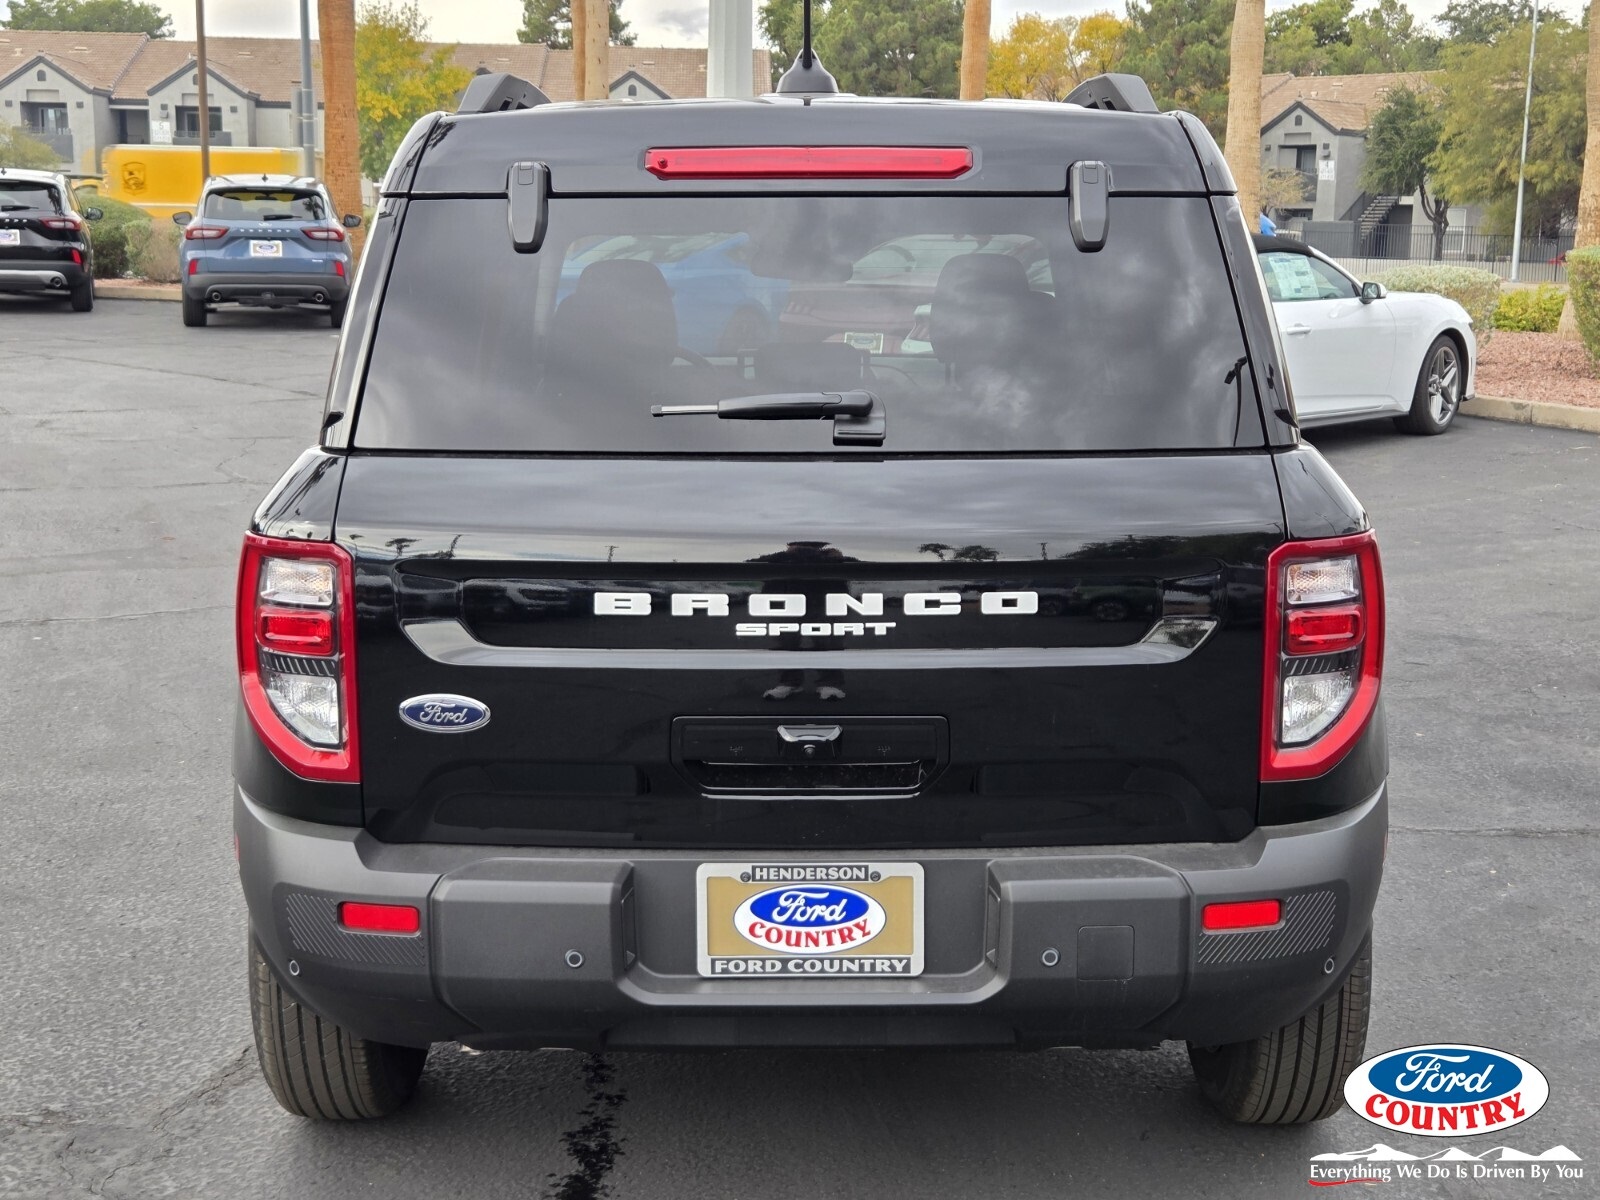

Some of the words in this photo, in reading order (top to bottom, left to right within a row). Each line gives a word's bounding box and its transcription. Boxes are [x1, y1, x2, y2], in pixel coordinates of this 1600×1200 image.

[594, 591, 1039, 616] BRONCO
[735, 622, 896, 636] SPORT
[419, 702, 468, 723] Ford
[755, 867, 866, 880] HENDERSON
[771, 890, 848, 922] Ford
[748, 918, 871, 947] COUNTRY
[715, 959, 782, 973] FORD
[787, 959, 908, 973] COUNTRY
